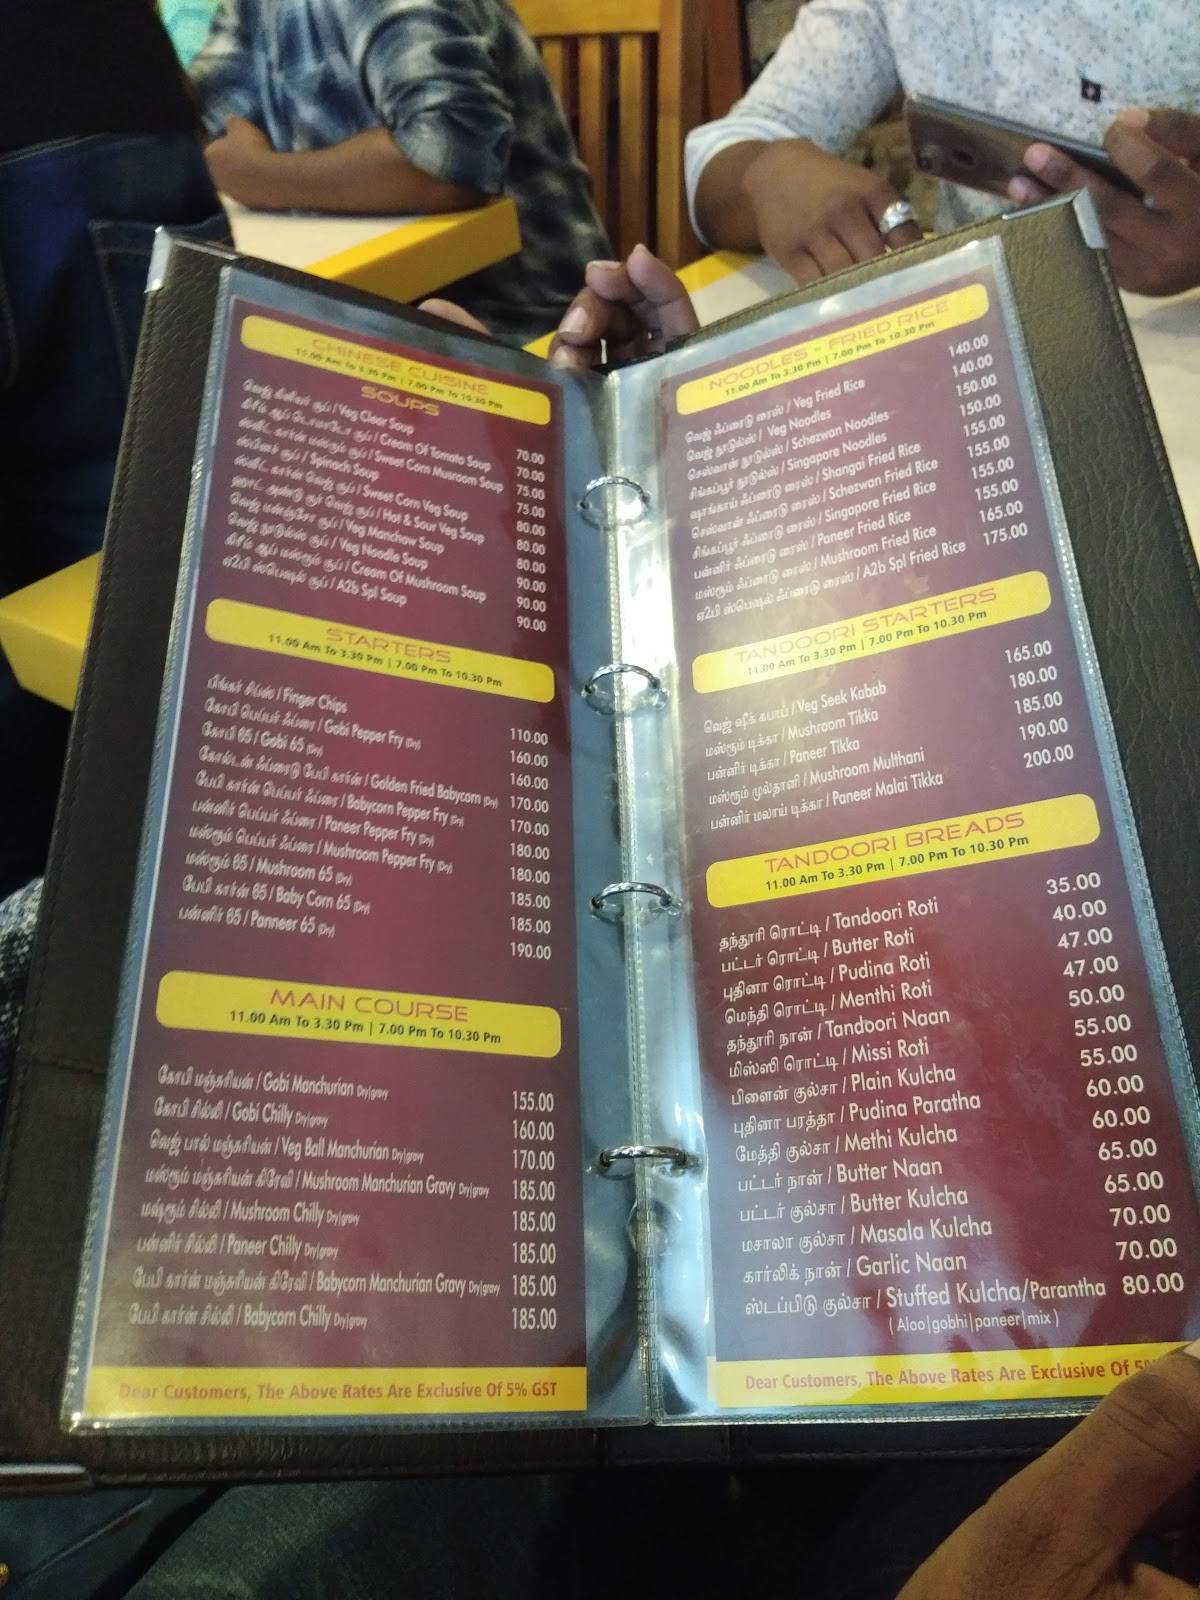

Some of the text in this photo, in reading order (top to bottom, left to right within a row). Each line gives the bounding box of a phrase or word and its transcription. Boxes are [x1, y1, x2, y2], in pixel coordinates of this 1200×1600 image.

[708, 301, 949, 391] NOODLES FRIED RICE
[948, 334, 989, 358] 140.00
[360, 385, 440, 417] SOUPS
[792, 379, 865, 409] Veg Fried Rice
[979, 500, 1024, 523] 165.00
[819, 526, 937, 568] Mushroom Fried Rice
[983, 522, 1028, 546] 175.00
[339, 537, 360, 557] Veg
[361, 543, 400, 563] Noodle
[401, 551, 429, 571] Soup
[862, 540, 966, 579] A2b Spl Fried Rice
[336, 579, 407, 608] A2b Spl Soup
[516, 576, 546, 594] 90.00
[516, 615, 547, 633] 90.00
[734, 586, 998, 663] TANDOORI STARTERS
[326, 627, 451, 664] STARTERS
[1004, 640, 1053, 664] 165.00
[1009, 665, 1058, 689] 180.00
[282, 687, 348, 715] Finger Chips
[795, 679, 887, 714] Veg Seek Kabab
[1014, 691, 1063, 715] 185.00
[510, 727, 548, 746] 110.00
[787, 707, 879, 741] Mushroom Tikka
[1019, 717, 1069, 741] 190.00
[789, 736, 860, 765] Paneer Tikka
[1023, 744, 1074, 769] 200.00
[809, 746, 925, 785] Mushroom Multhani
[832, 770, 944, 806] Paneer Malai Tikka
[764, 811, 1025, 873] TANDOORI BREADS
[322, 841, 436, 874] Mushroom Pepper Fry
[765, 836, 1029, 891] 11.00 Am To 3.30 Pm 7.00 Pm To 10.30 Pm
[510, 866, 550, 885] 180.00
[1046, 872, 1101, 895] 35.00
[275, 885, 351, 911] Baby Corn 65
[1052, 899, 1107, 921] 40.00
[510, 916, 551, 935] 185.00
[832, 902, 903, 929] Tandoori
[907, 896, 939, 917] Roti
[832, 936, 879, 956] Butter
[883, 926, 915, 948] Roti
[1057, 926, 1113, 949] 47.00
[838, 951, 931, 982] Pudina Roti
[1063, 955, 1119, 978] 47.00
[270, 988, 468, 1023] MAIN COURSE
[839, 978, 933, 1009] Menthi Roti
[1068, 984, 1125, 1007] 50.00
[230, 1010, 501, 1044] 11.00 Am To 3.30 Pm 7.00 Pm To 10.30 Pm
[824, 1009, 950, 1038] Tandoori Naan
[1074, 1013, 1132, 1037] 55.00
[851, 1035, 930, 1064] Missi Roti
[1080, 1044, 1138, 1067] 55.00
[262, 1071, 355, 1096] Gobi Manchurian
[851, 1063, 956, 1092] Plain Kulcha
[1086, 1074, 1144, 1098] 60.00
[512, 1090, 554, 1112] 155.00
[849, 1090, 981, 1122] Pudina Paratha
[1092, 1105, 1151, 1129] 60.00
[512, 1119, 555, 1142] 160.00
[844, 1123, 958, 1152] Methi Kulcha
[281, 1136, 389, 1162] Veg Ball Manchurian
[513, 1149, 555, 1171] 170.00
[1098, 1137, 1157, 1161] 65.00
[836, 1163, 888, 1183] Butter
[892, 1157, 943, 1178] Naan
[229, 1199, 325, 1228] Mushroom Chilly
[512, 1210, 556, 1233] 185.00
[1109, 1203, 1171, 1227] 70.00
[860, 1219, 925, 1244] Masala
[929, 1214, 993, 1240] Kulcha
[1115, 1237, 1178, 1261] 70.00
[856, 1250, 967, 1277] Garlic Naan
[886, 1282, 951, 1308] Stuffed
[1122, 1272, 1185, 1295] 80.00
[120, 1383, 162, 1400] Dear
[257, 1383, 285, 1400] The
[289, 1383, 338, 1400] Above
[342, 1384, 384, 1399] Rates
[386, 1383, 413, 1399] Are
[416, 1381, 482, 1398] Exclusive
[486, 1381, 503, 1398] Of
[506, 1382, 528, 1398] 5%
[531, 1381, 557, 1397] GST
